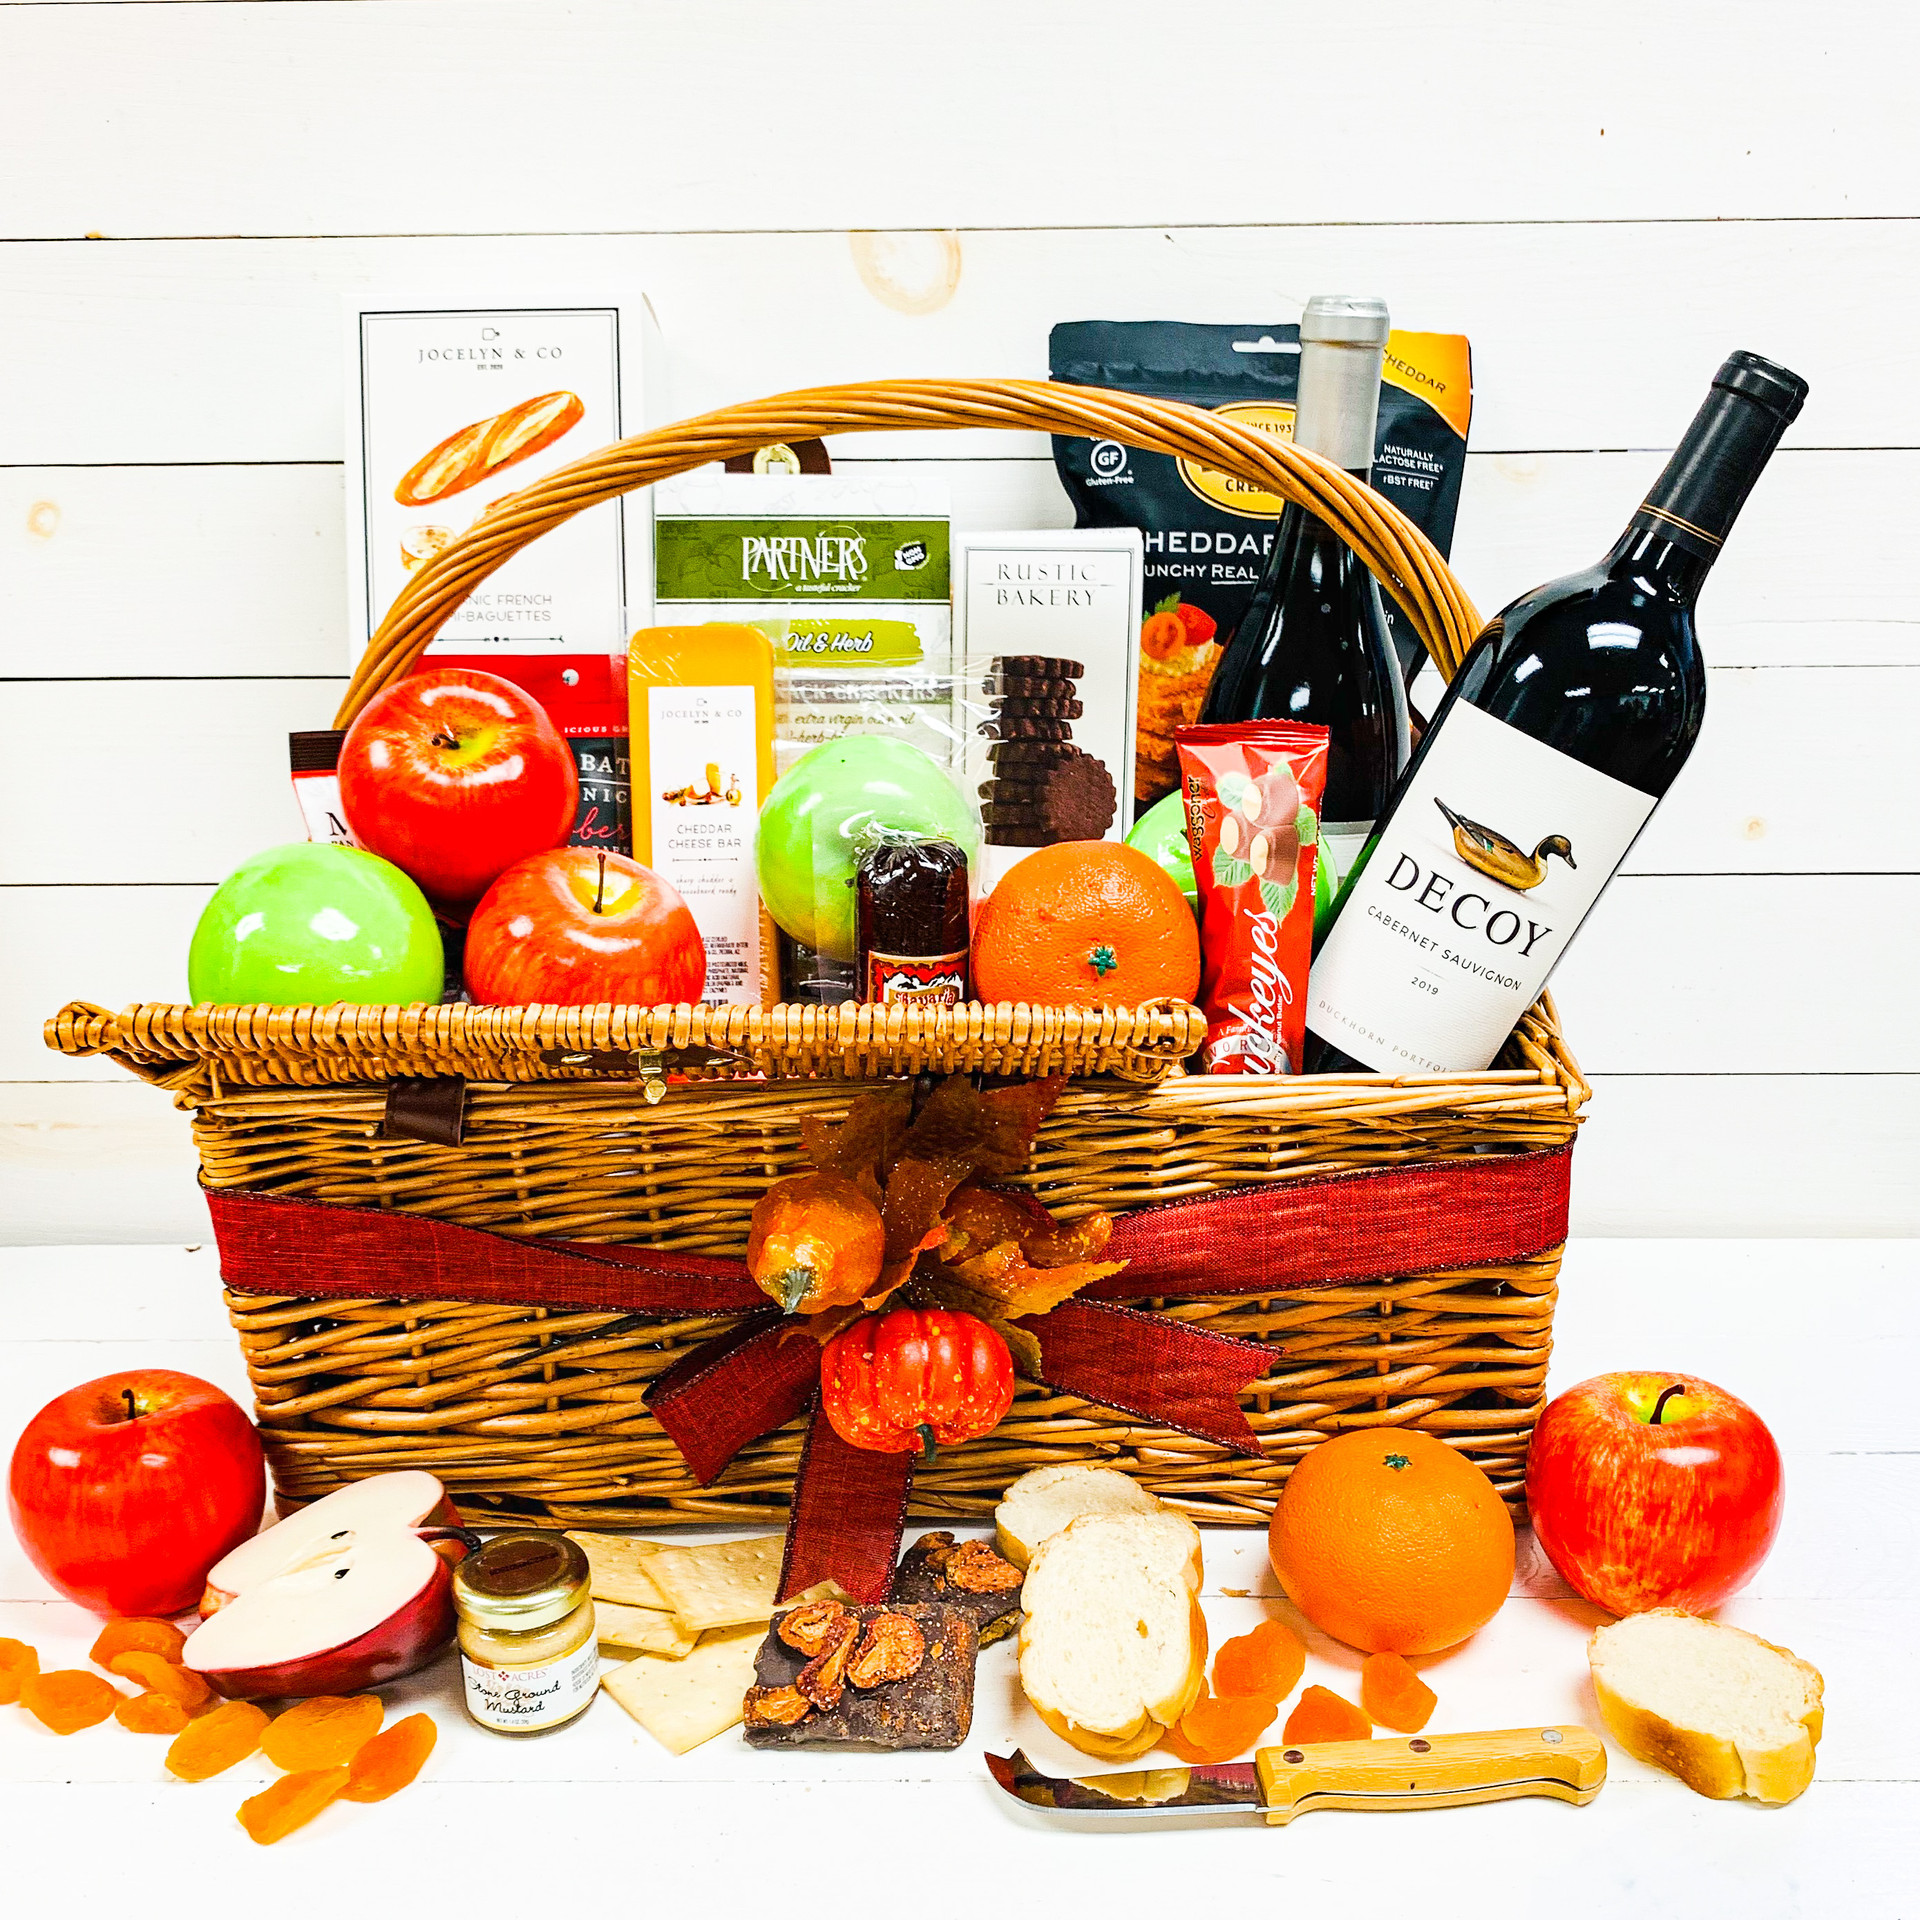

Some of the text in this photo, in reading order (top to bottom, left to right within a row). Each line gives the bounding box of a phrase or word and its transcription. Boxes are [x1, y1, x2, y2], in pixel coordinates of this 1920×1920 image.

[418, 346, 563, 363] JOCELYN & CO
[1097, 451, 1120, 467] GF
[1383, 443, 1434, 462] NATURALLY
[742, 528, 869, 582] PARTNERS
[998, 563, 1097, 580] RUSTIC
[1211, 564, 1260, 579] REAL
[497, 594, 553, 606] FRENCH
[997, 588, 1096, 606] BAKERY
[813, 632, 831, 652] &
[830, 630, 874, 653] Herb
[661, 710, 710, 720] JOCELYN
[727, 709, 743, 718] CO
[829, 713, 864, 730] virgin
[677, 824, 732, 834] CHEDDAR
[668, 838, 742, 849] CHEESE BAR
[1385, 852, 1552, 958] DECOY
[1367, 905, 1522, 991] CABERNET SAUVIGNON
[1228, 908, 1293, 1075] uckeyes
[1410, 976, 1440, 996] 2019
[1318, 1000, 1386, 1046] DUCKHORN
[472, 1667, 547, 1682] LOST ACRES
[468, 1676, 561, 1706] Stone Ground
[484, 1699, 545, 1715] Mustard
